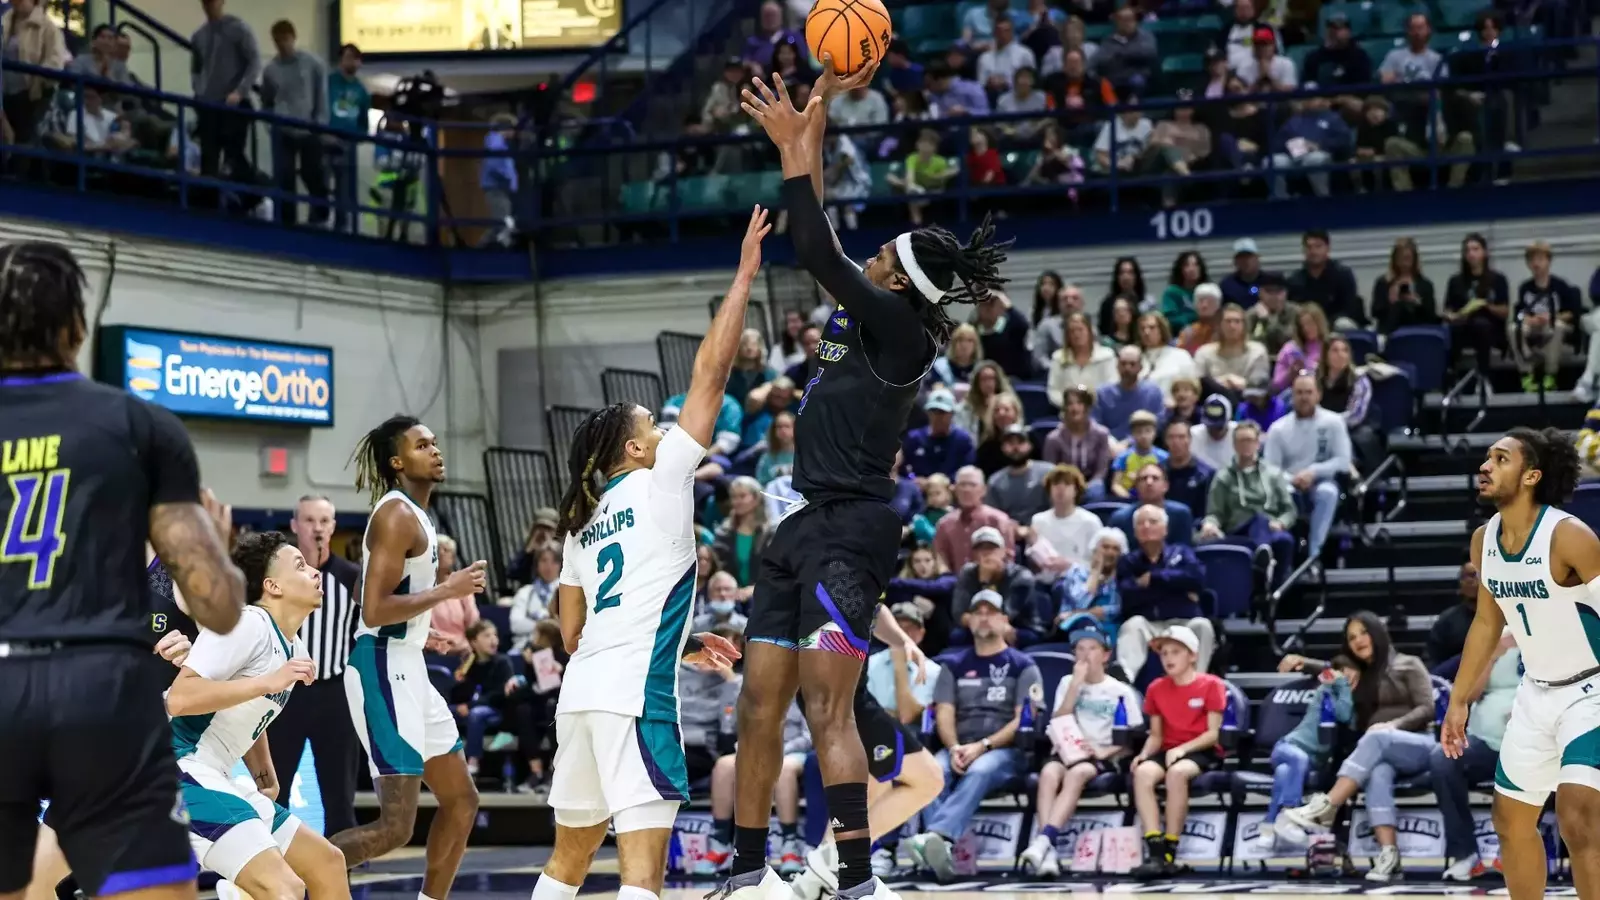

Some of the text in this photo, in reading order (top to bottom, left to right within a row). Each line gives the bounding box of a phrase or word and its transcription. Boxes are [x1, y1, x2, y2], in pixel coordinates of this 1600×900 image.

[1150, 208, 1213, 239] 100
[165, 354, 329, 411] EmergeOrtho
[2, 434, 61, 473] LANE
[0, 468, 71, 590] 4
[580, 507, 635, 549] PHILLIPS
[1525, 557, 1542, 565] CAA
[593, 542, 625, 614] 2
[1487, 578, 1549, 599] SEAHAWKS
[1516, 603, 1532, 636] 1
[1272, 689, 1316, 704] UNC
[252, 709, 275, 740] 0
